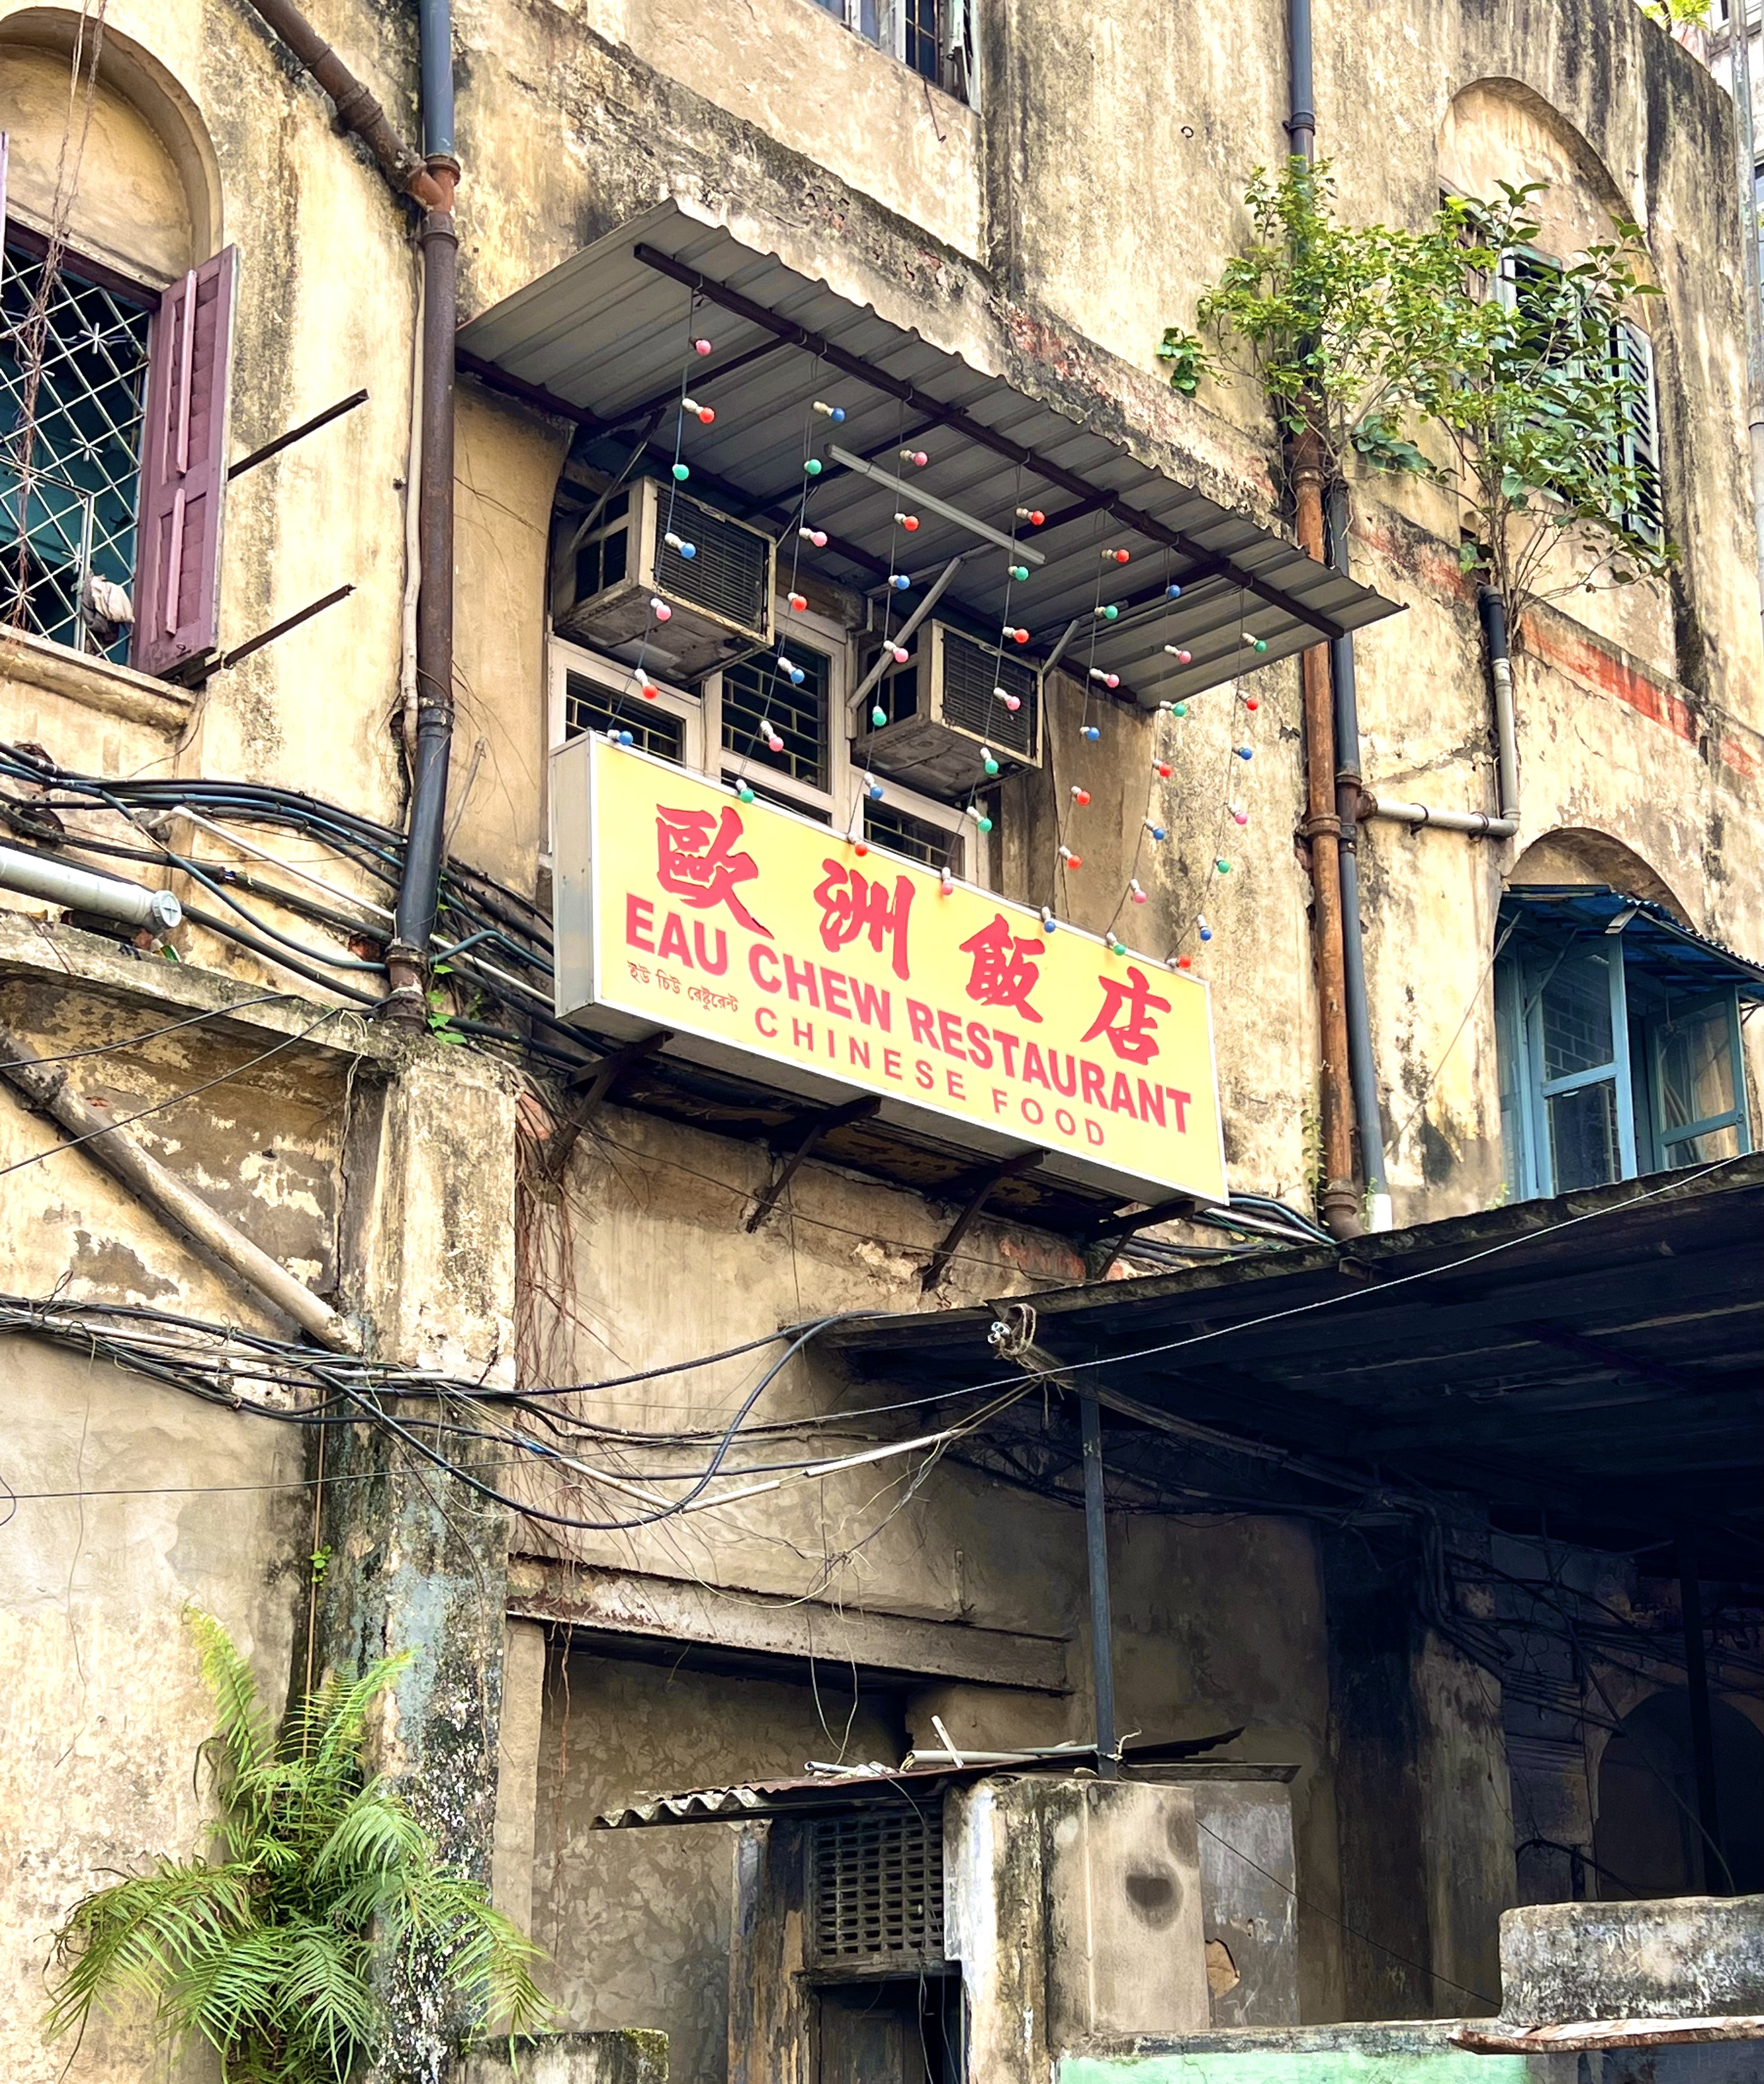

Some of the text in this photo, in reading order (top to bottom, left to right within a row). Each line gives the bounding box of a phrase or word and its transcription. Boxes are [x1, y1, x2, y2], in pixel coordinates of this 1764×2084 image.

[626, 894, 1191, 1133] EAU CHEW RESTAURANT
[627, 960, 651, 983] ইউ
[655, 969, 682, 994] চিউ
[655, 804, 1171, 1065] 歐洲飯店
[756, 1008, 1104, 1145] CHINESE FOOD
